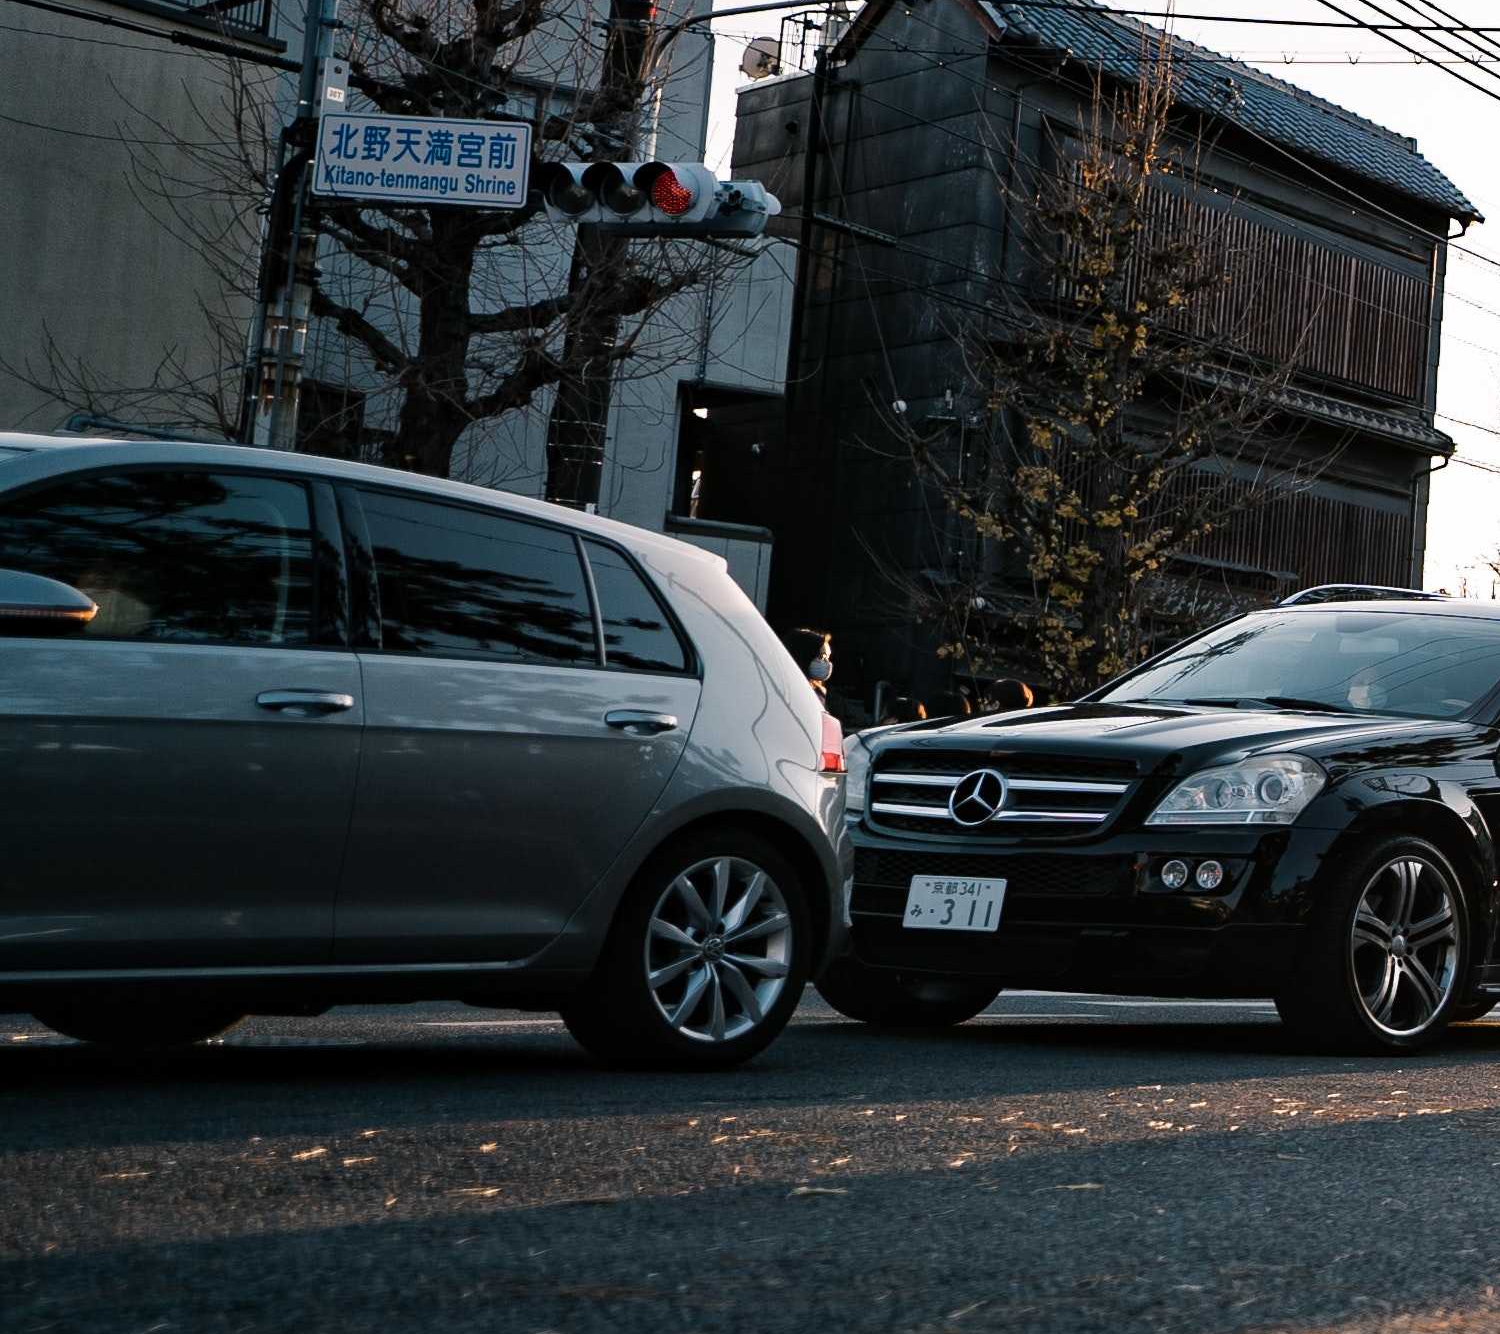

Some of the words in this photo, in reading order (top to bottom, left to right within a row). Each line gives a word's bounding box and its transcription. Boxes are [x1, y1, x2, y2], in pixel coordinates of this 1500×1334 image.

[329, 122, 518, 170] 北野天満宮前
[324, 164, 459, 195] Kitano-tenmangu
[464, 173, 516, 196] Shrine
